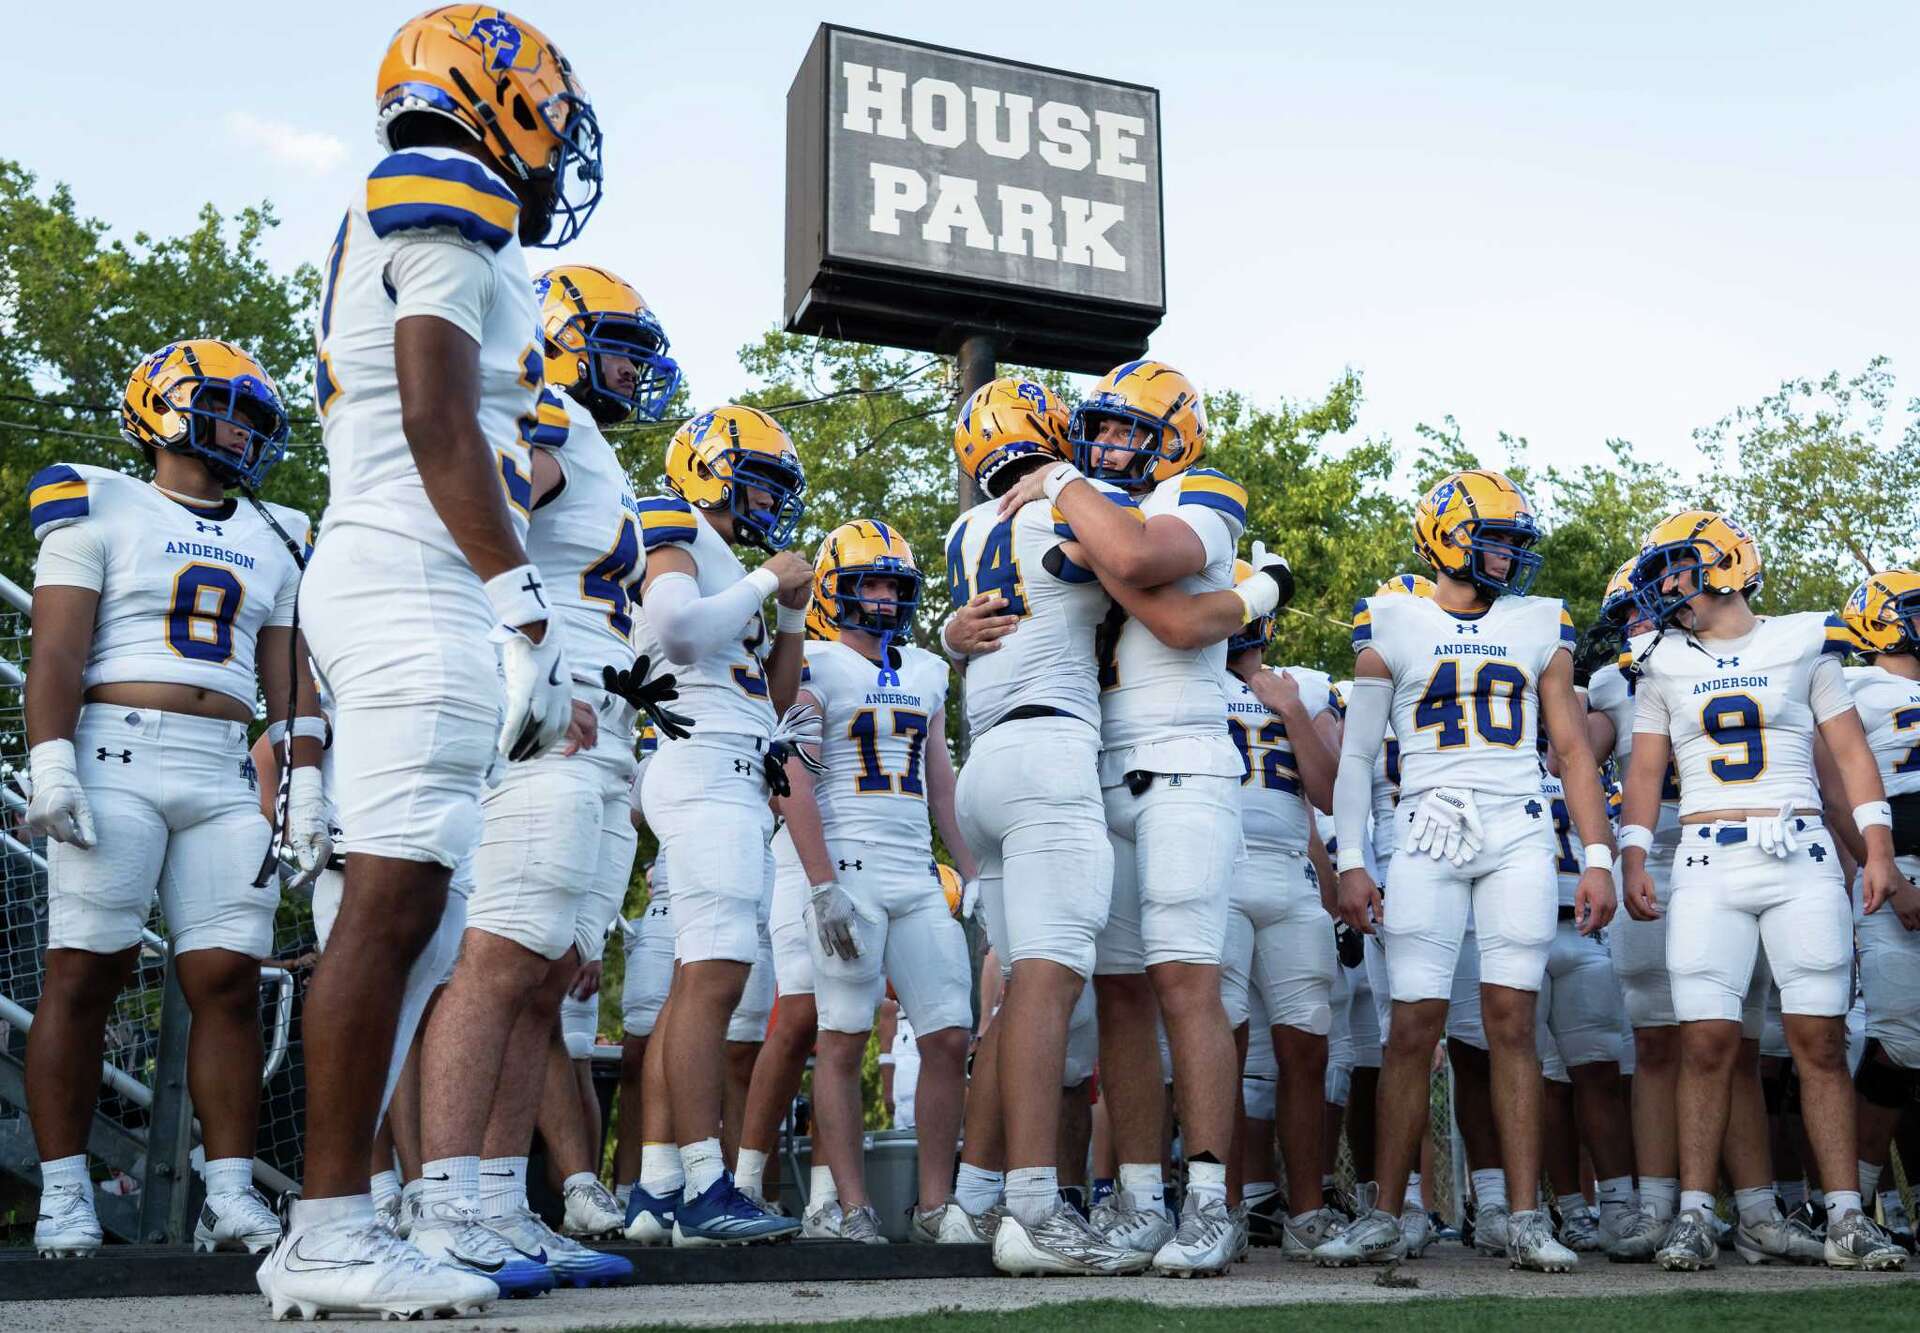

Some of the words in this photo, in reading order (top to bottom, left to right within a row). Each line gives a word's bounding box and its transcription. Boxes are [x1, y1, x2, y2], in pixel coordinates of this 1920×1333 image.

[842, 61, 1147, 183] HOUSE
[869, 162, 1126, 273] PARK
[164, 540, 256, 571] ANDERSON
[164, 560, 247, 667] 8
[1433, 641, 1508, 659] ANDERSON
[864, 692, 922, 707] ANDERSON
[1413, 658, 1532, 751] 40
[1692, 675, 1769, 695] ANDERSON
[848, 706, 930, 800] 17
[1699, 691, 1767, 785] 9
